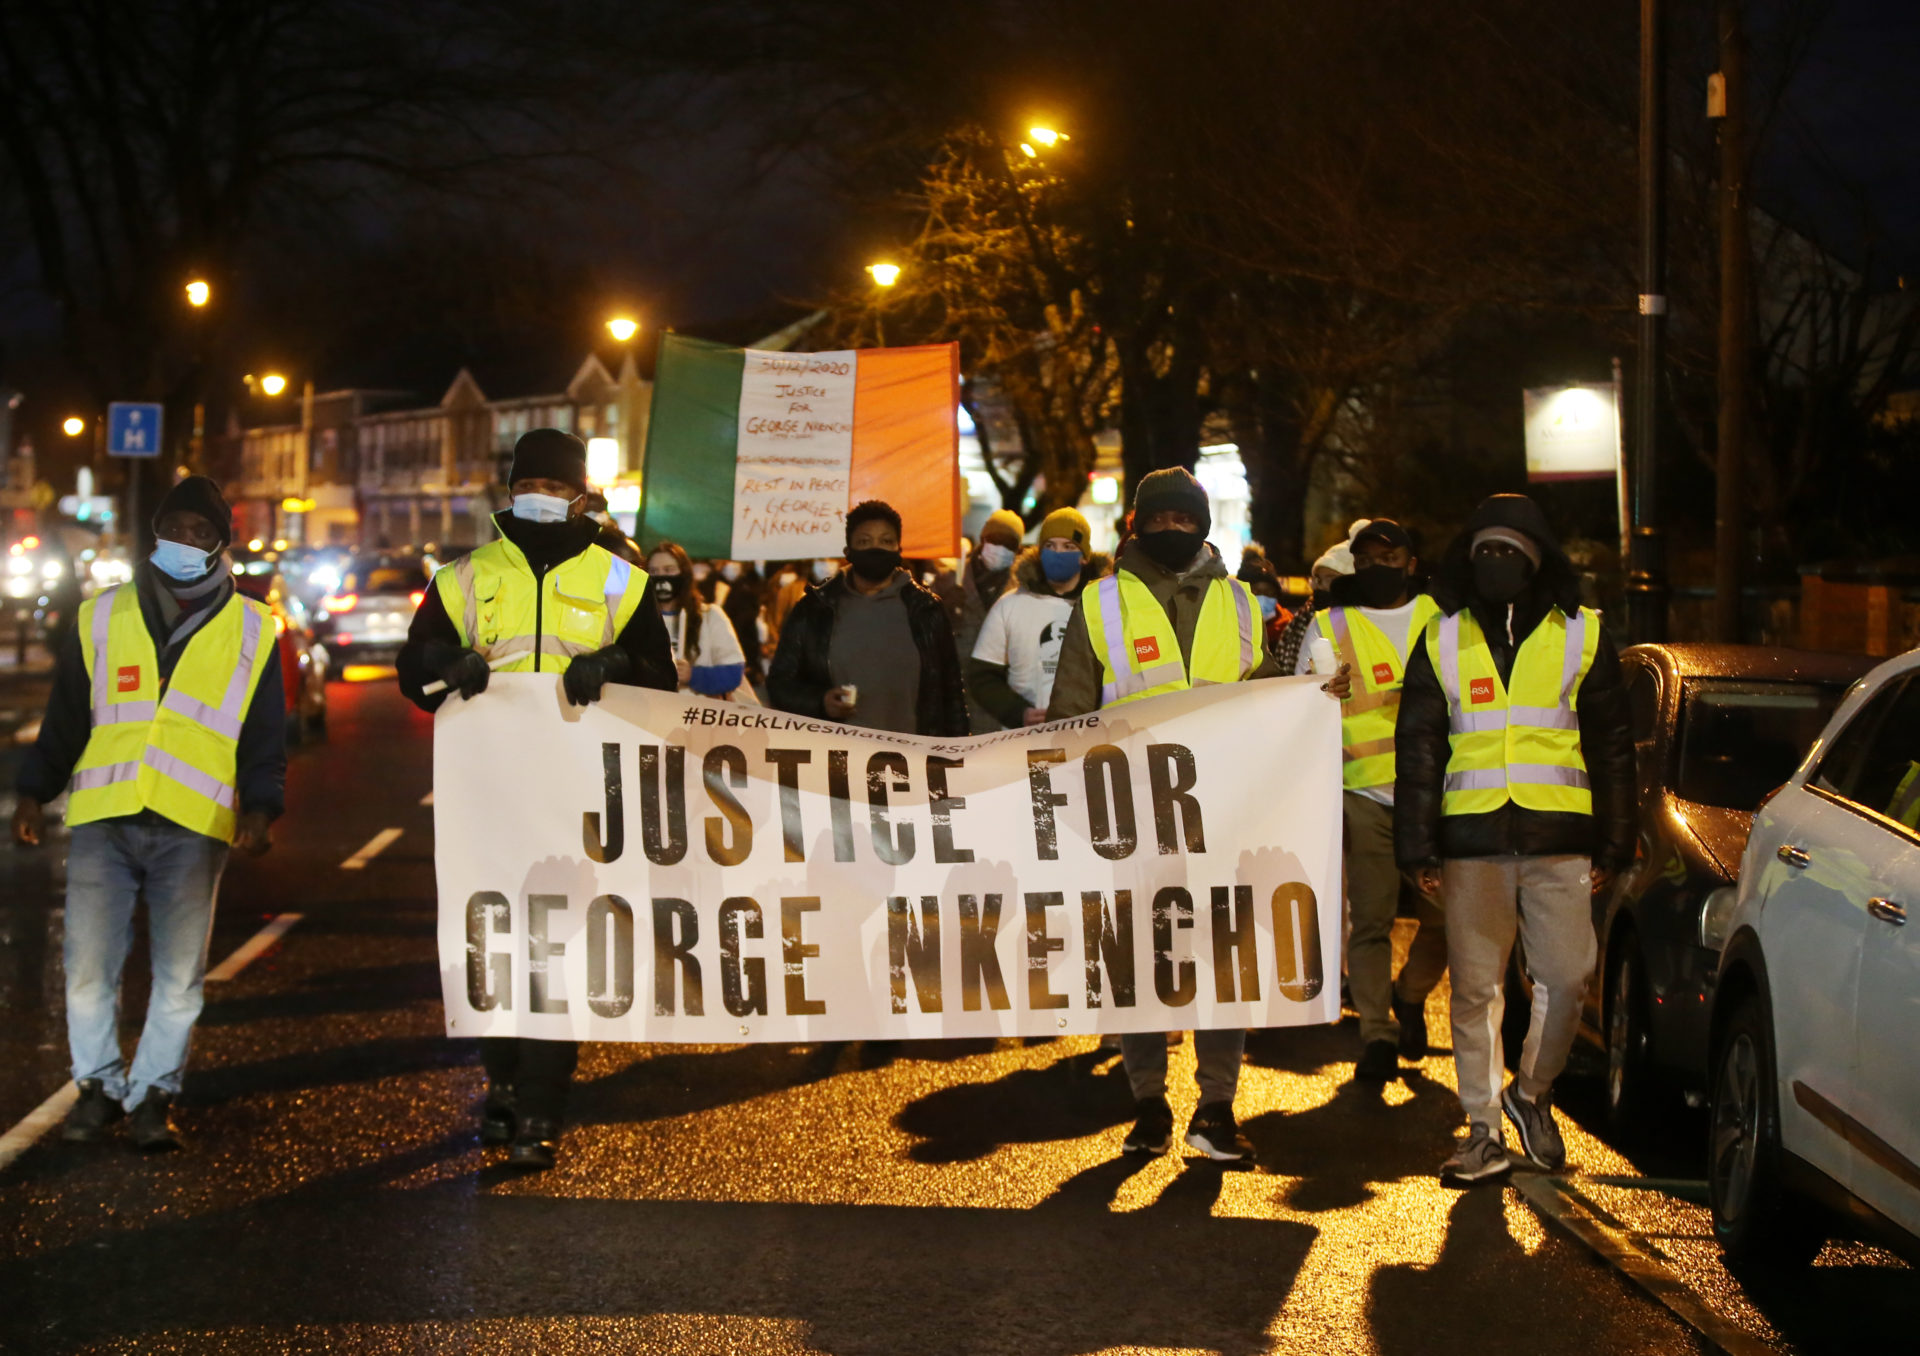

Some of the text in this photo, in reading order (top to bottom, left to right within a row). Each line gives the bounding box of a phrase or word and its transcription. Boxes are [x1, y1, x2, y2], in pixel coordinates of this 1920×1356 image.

[788, 402, 814, 415] FOR
[745, 416, 799, 435] GEORGE
[741, 477, 846, 495] REST IN PEACE
[765, 497, 831, 518] GEORGE
[1135, 644, 1154, 655] RSA
[1471, 686, 1490, 696] RSA
[682, 706, 1099, 754] #BlackLivesMatter #SayHisName
[582, 741, 1208, 867] JUSTICE FOR
[465, 880, 1324, 1018] GEORGE NKENCHO
